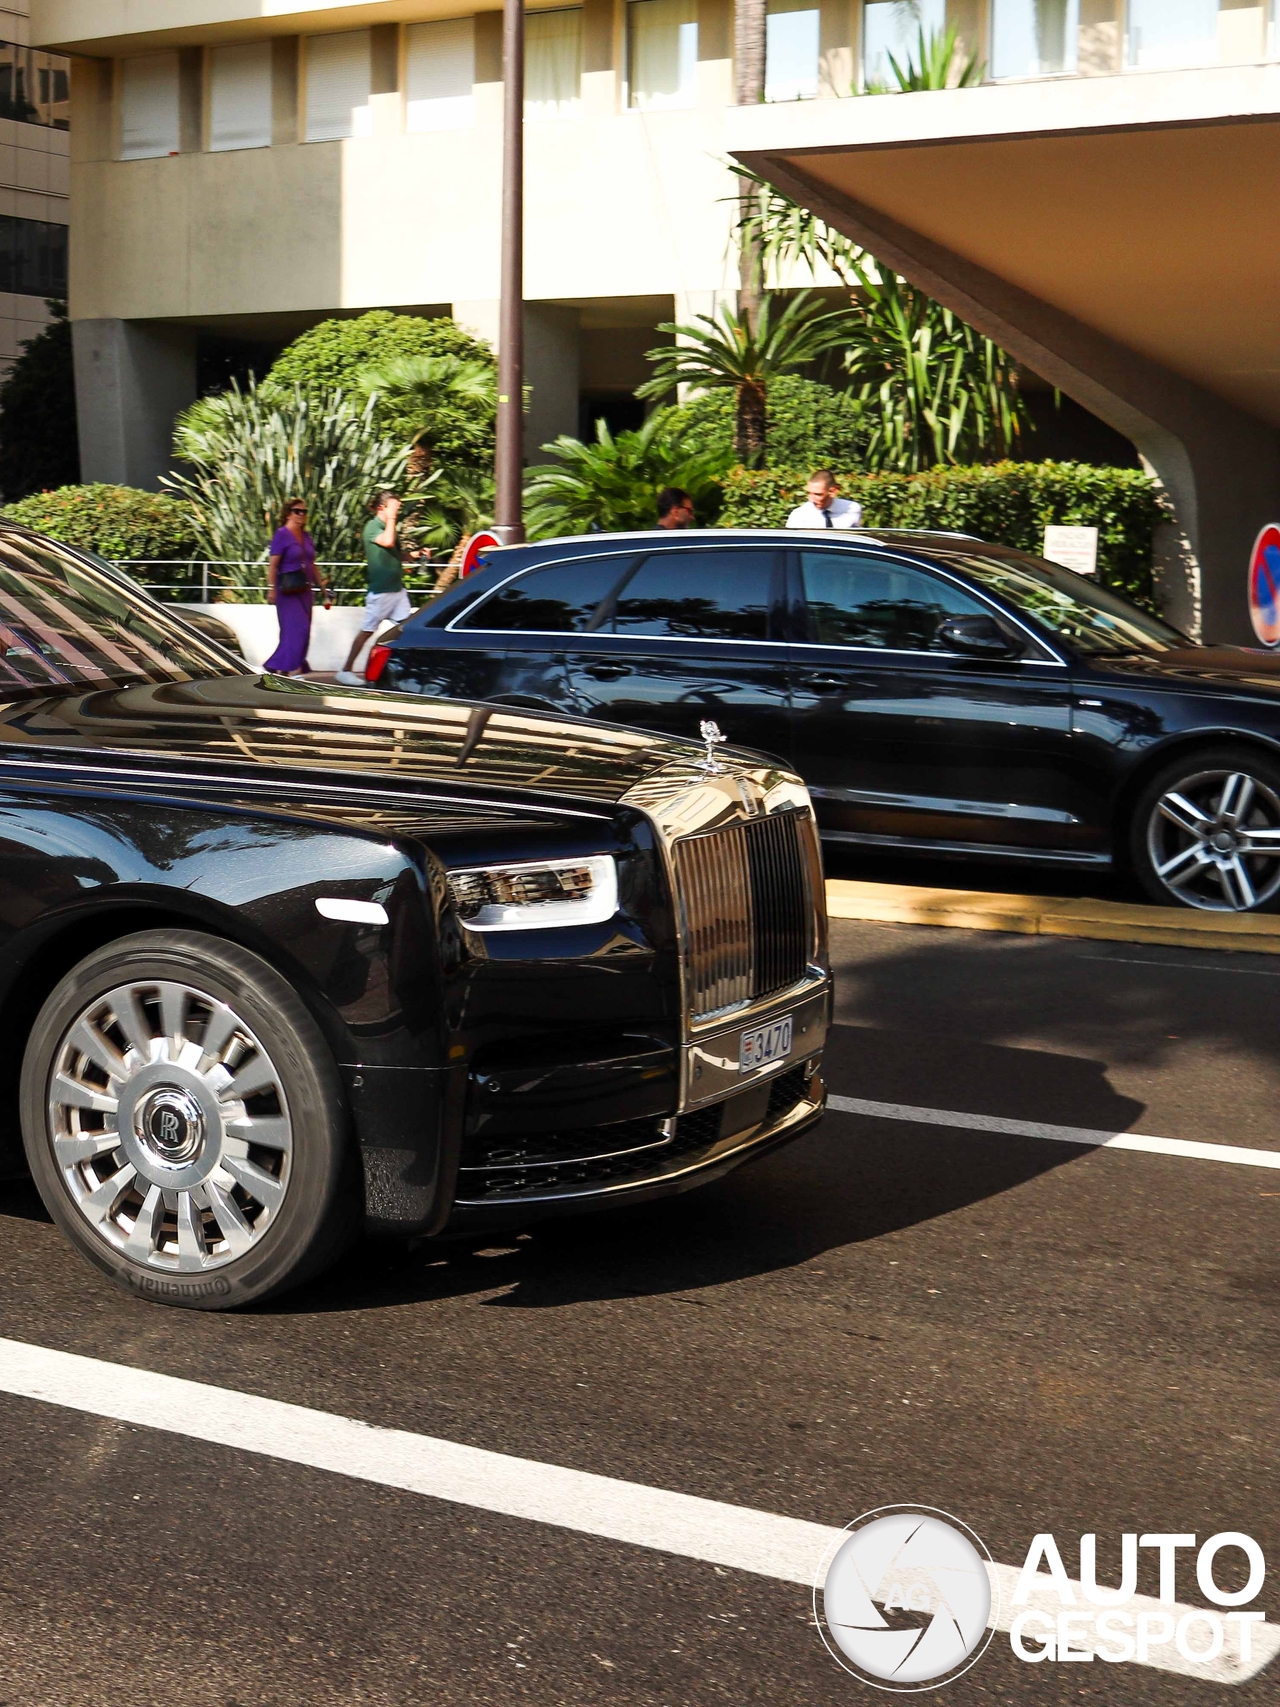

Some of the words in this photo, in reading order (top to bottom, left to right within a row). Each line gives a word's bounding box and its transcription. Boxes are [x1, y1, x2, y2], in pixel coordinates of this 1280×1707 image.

[755, 1022, 789, 1063] 3470
[160, 1111, 179, 1143] RR
[139, 1275, 232, 1300] Continental
